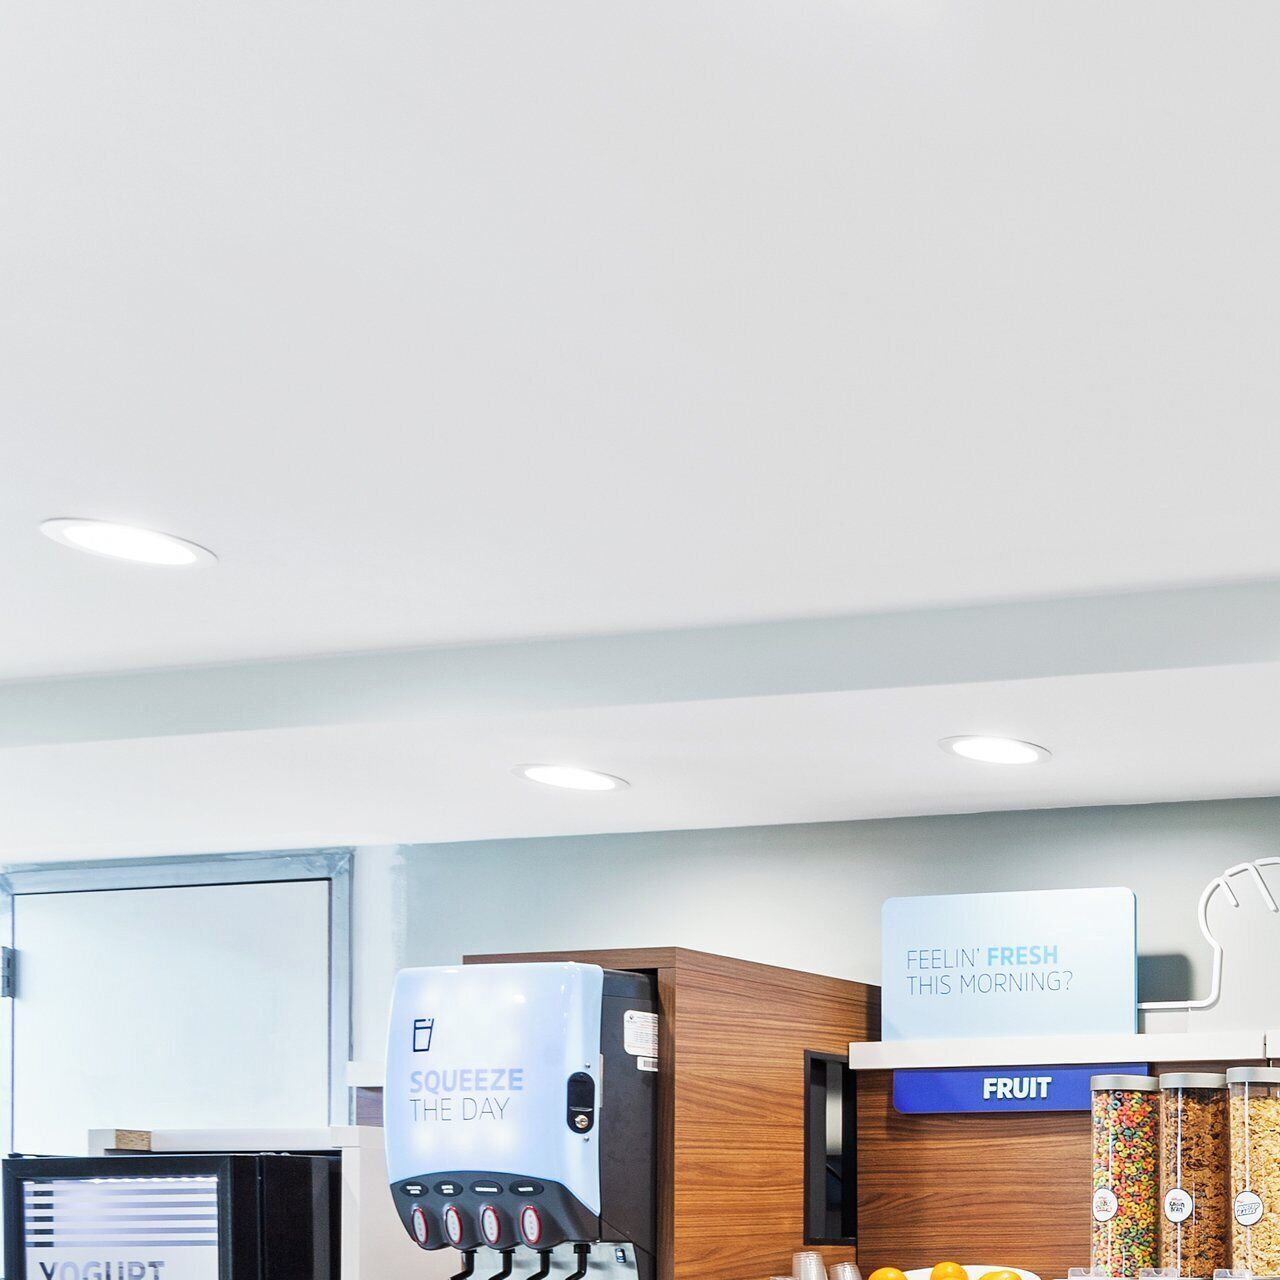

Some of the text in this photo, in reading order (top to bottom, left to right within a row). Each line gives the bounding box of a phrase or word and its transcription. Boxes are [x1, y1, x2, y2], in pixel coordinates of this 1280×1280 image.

[906, 945, 1058, 970] FEELIN' FRESH
[906, 970, 1073, 996] THIS MORNING?
[409, 1068, 524, 1095] SQUEEZE
[982, 1076, 1052, 1100] FRUIT
[409, 1096, 511, 1121] THE DAY
